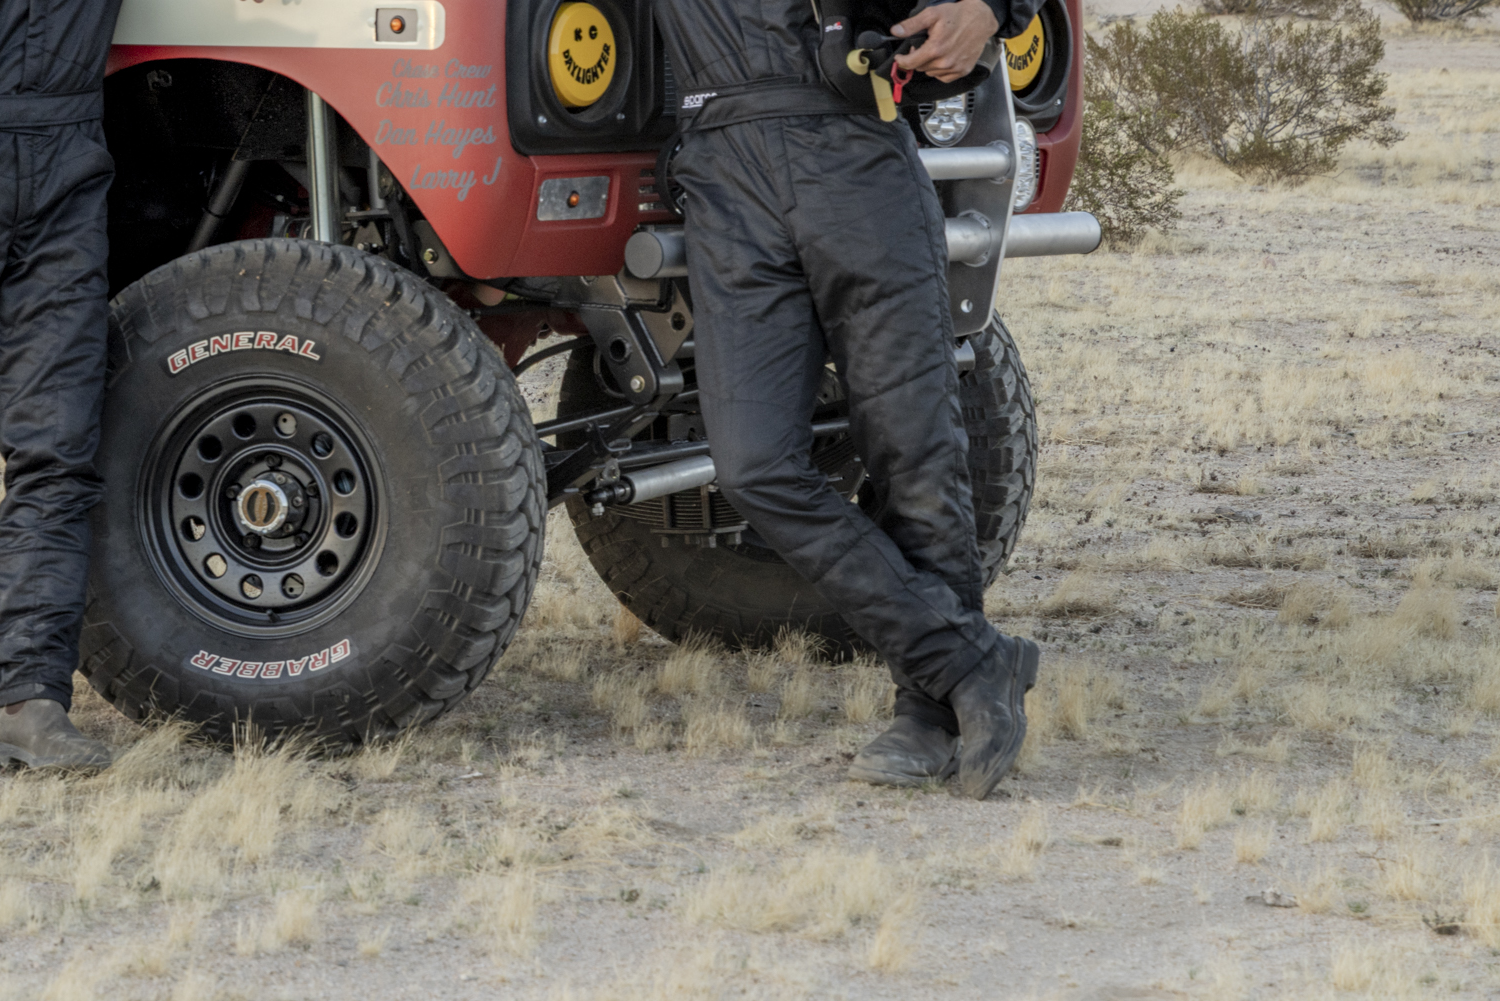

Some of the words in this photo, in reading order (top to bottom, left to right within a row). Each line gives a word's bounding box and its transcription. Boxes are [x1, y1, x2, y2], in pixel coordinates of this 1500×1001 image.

[392, 58, 440, 79] Chase
[445, 58, 492, 79] Crew
[563, 43, 611, 84] DAYLIGHTER
[375, 81, 432, 108] Chris
[437, 82, 497, 108] Hunt
[375, 119, 418, 145] Dan
[424, 119, 497, 159] Hayes
[410, 164, 477, 202] Larry
[483, 156, 502, 185] J
[167, 330, 321, 375] GENERAL
[191, 639, 352, 679] GRABBER
